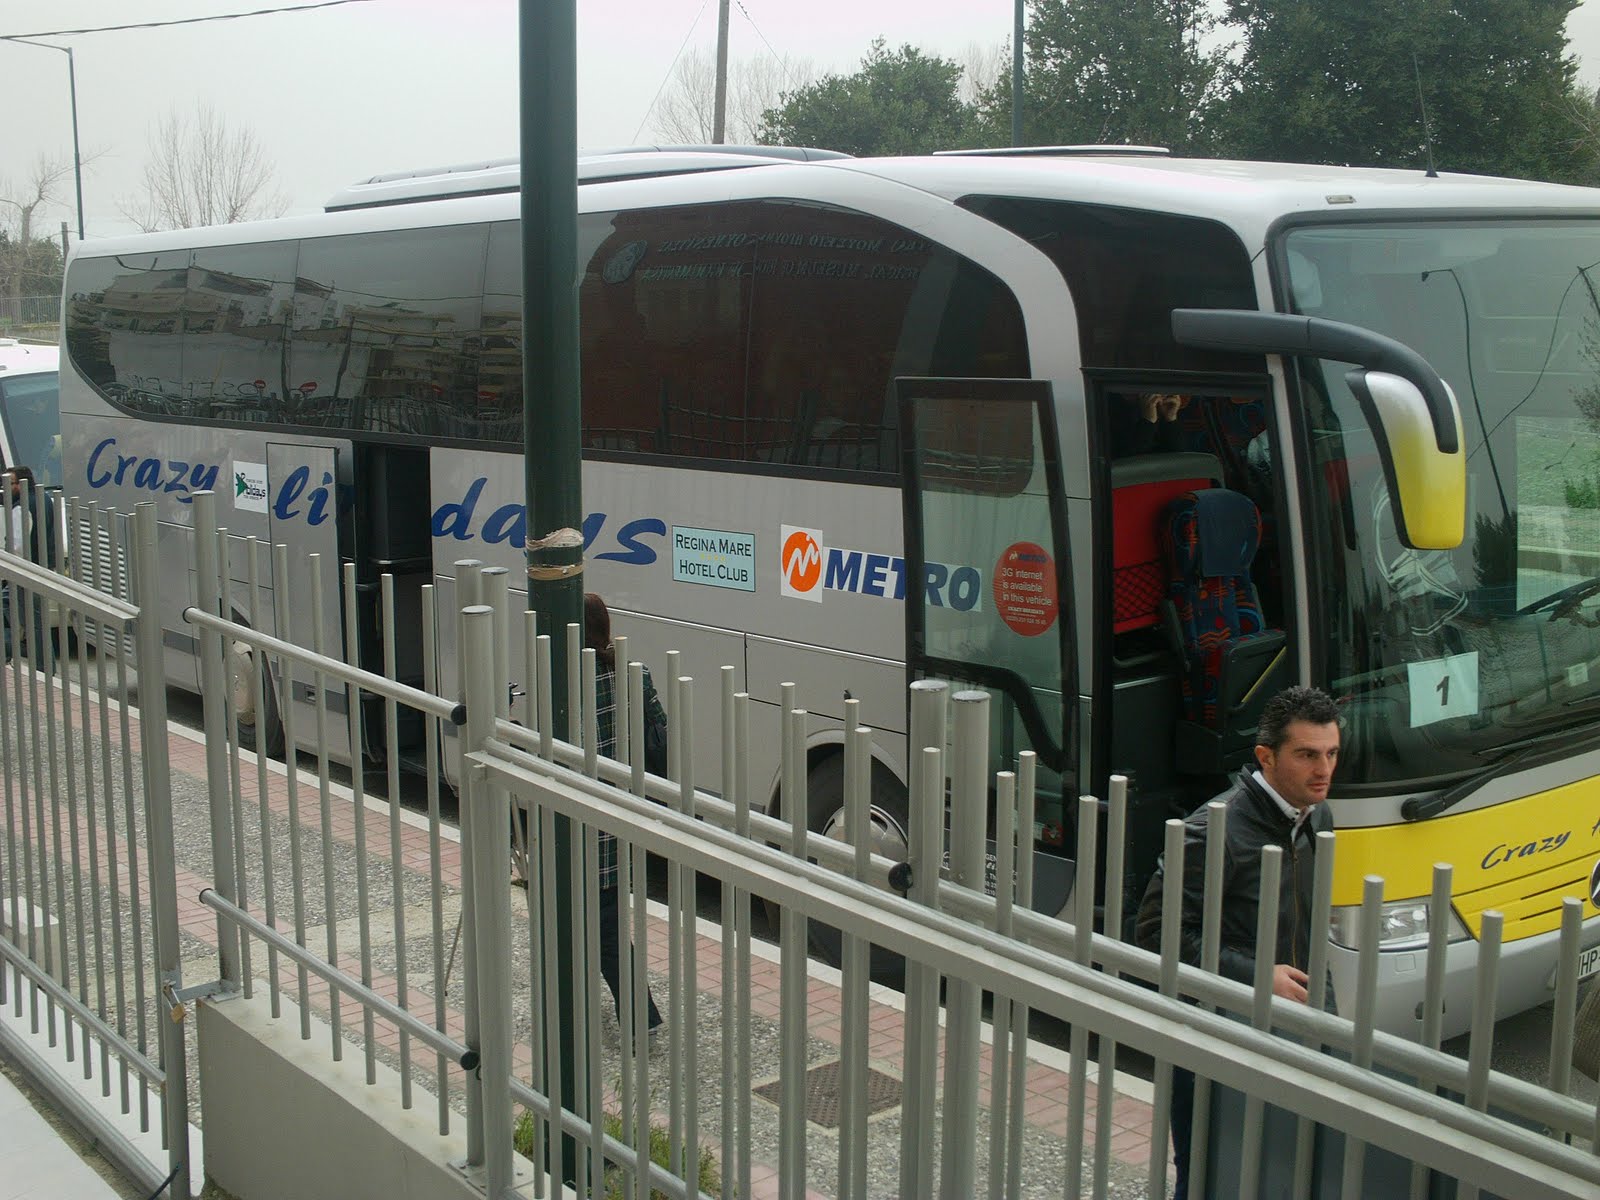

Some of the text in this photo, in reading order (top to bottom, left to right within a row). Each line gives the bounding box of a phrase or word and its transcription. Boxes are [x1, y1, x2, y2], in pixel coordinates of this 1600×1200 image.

[86, 438, 219, 503] Crazy
[675, 533, 752, 557] REGINA MARE
[679, 559, 748, 582] HOTEL CLUB
[824, 549, 981, 611] METRO
[1001, 567, 1043, 580] 3G internet
[1002, 580, 1043, 593] is available
[1002, 591, 1052, 606] in this vehicle
[1436, 675, 1450, 706] 1
[1481, 830, 1572, 870] Crazy
